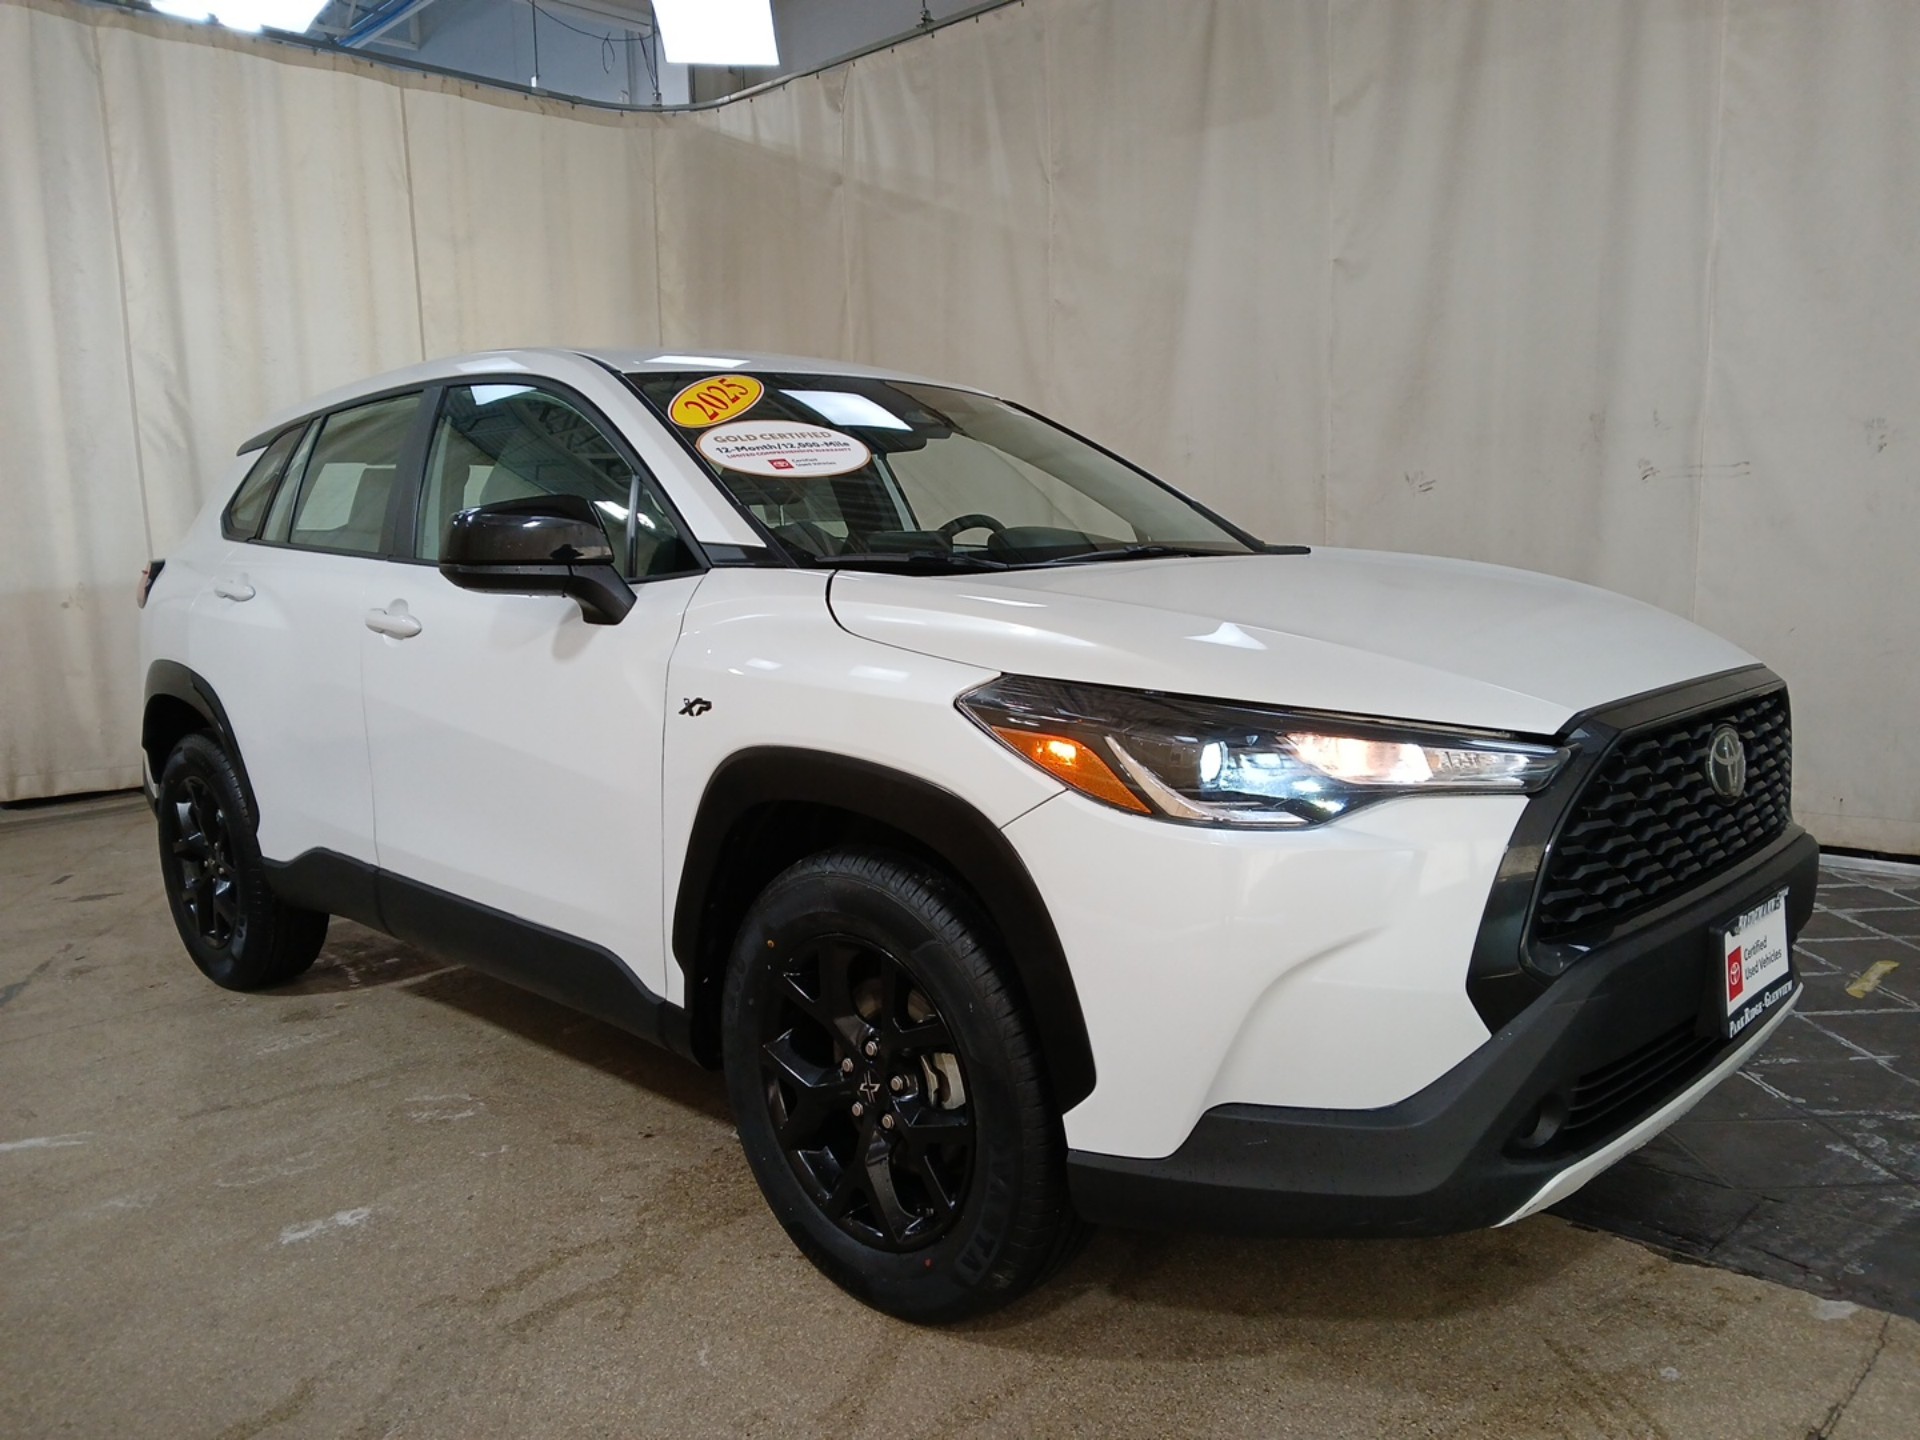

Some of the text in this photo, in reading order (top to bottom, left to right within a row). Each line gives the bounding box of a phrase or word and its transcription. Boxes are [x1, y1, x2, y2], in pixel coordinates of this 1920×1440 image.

[684, 378, 749, 421] 2025
[713, 431, 832, 443] GOLD CERTIFIED
[678, 697, 712, 717] XP
[1743, 935, 1768, 961] Certified
[1745, 949, 1783, 980] Used Vehicles
